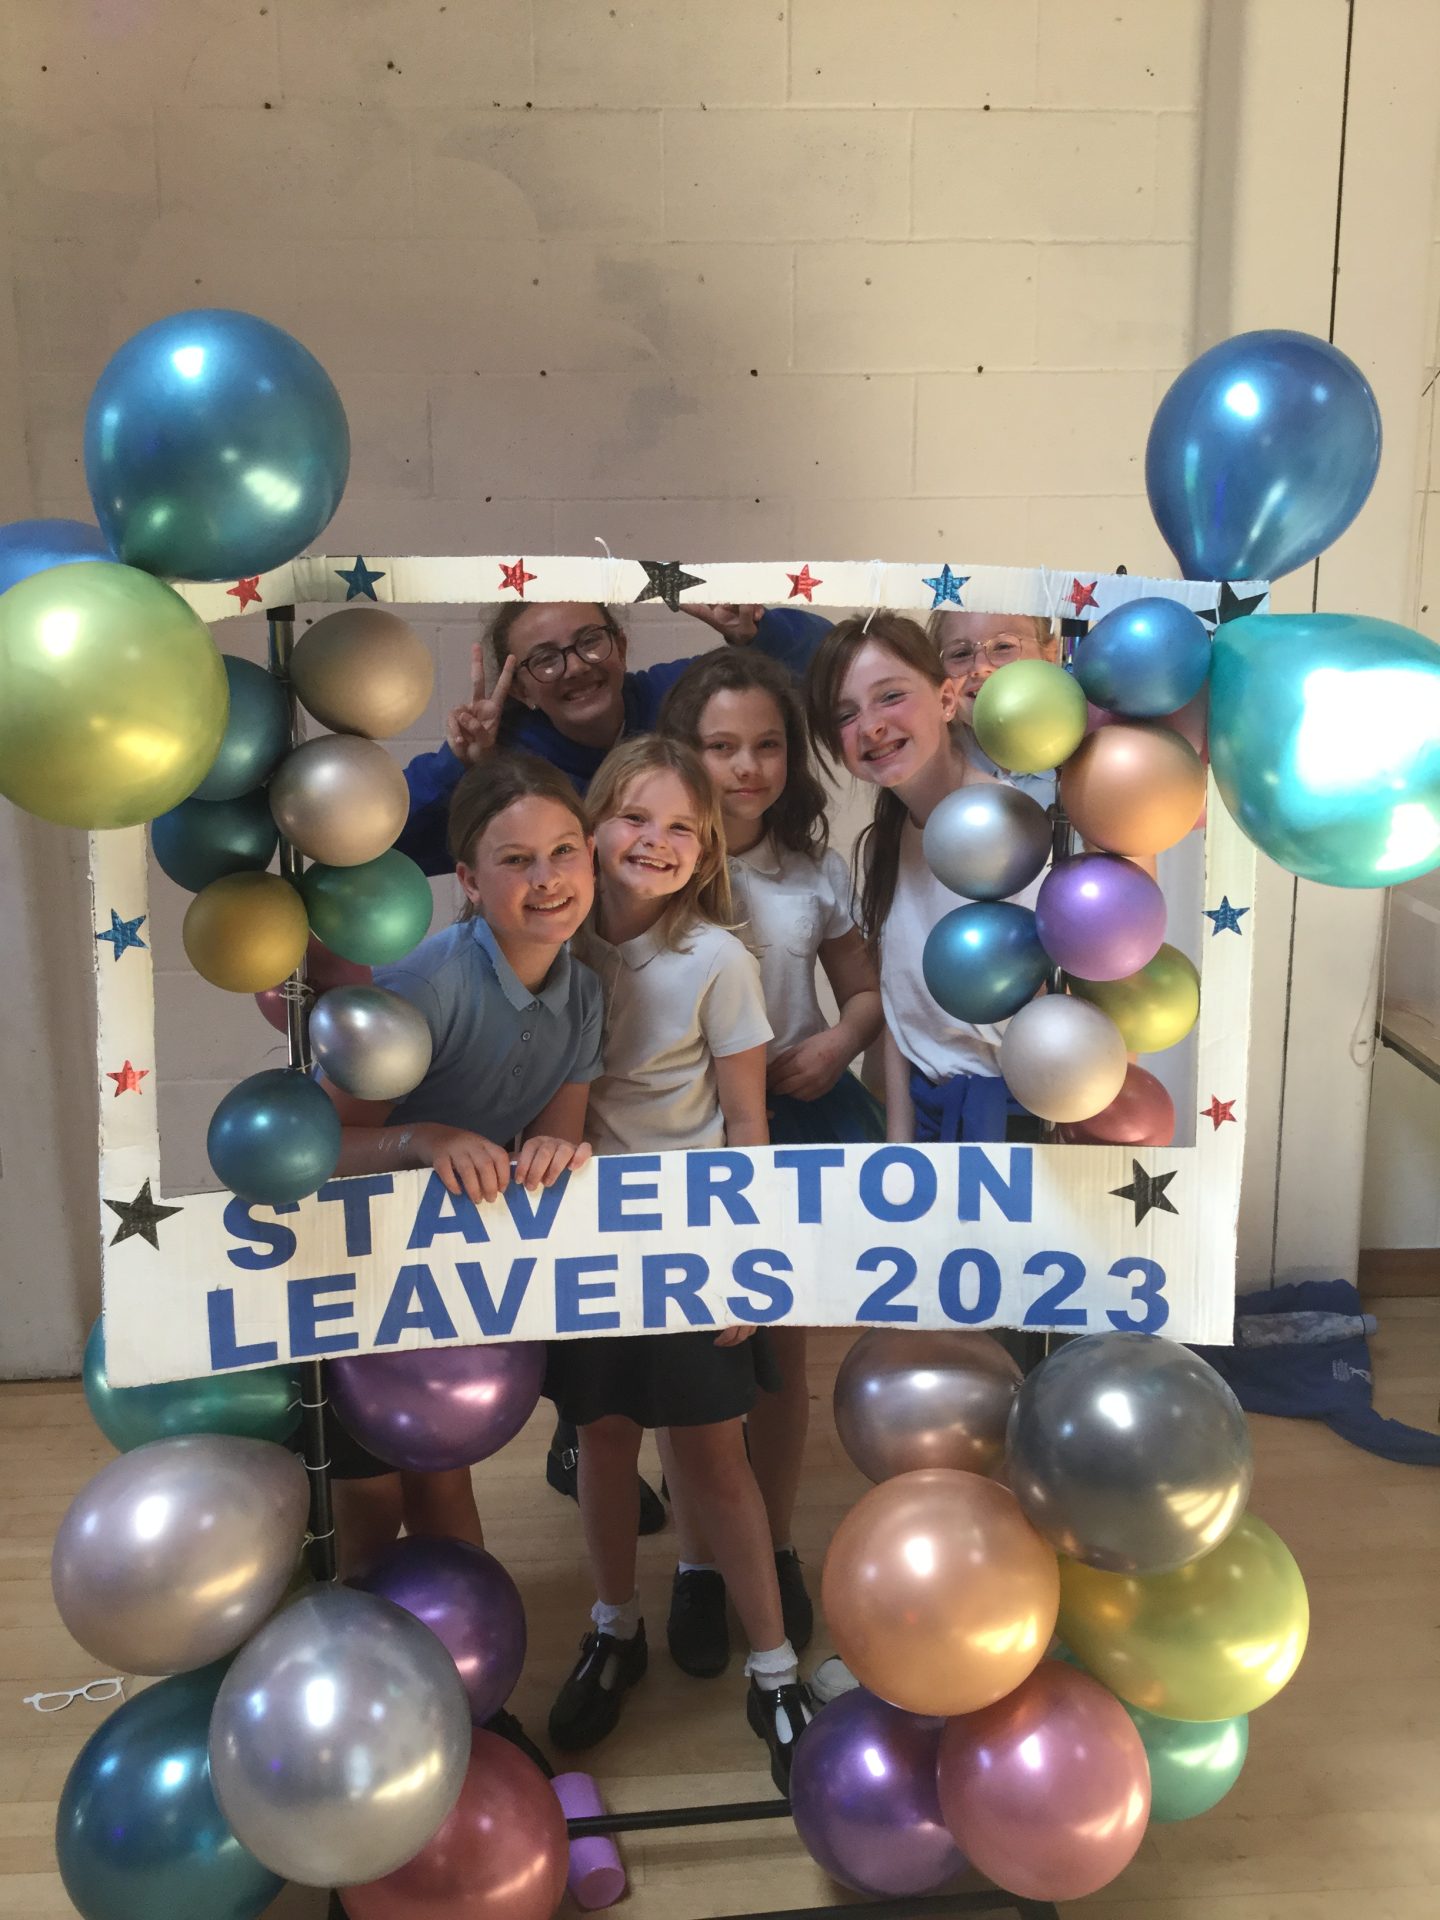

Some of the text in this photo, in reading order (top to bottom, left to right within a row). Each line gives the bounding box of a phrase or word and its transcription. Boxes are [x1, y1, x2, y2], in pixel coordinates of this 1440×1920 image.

[222, 1146, 1033, 1271] STAVERTON
[207, 1246, 1170, 1371] LEAVERS 2023
